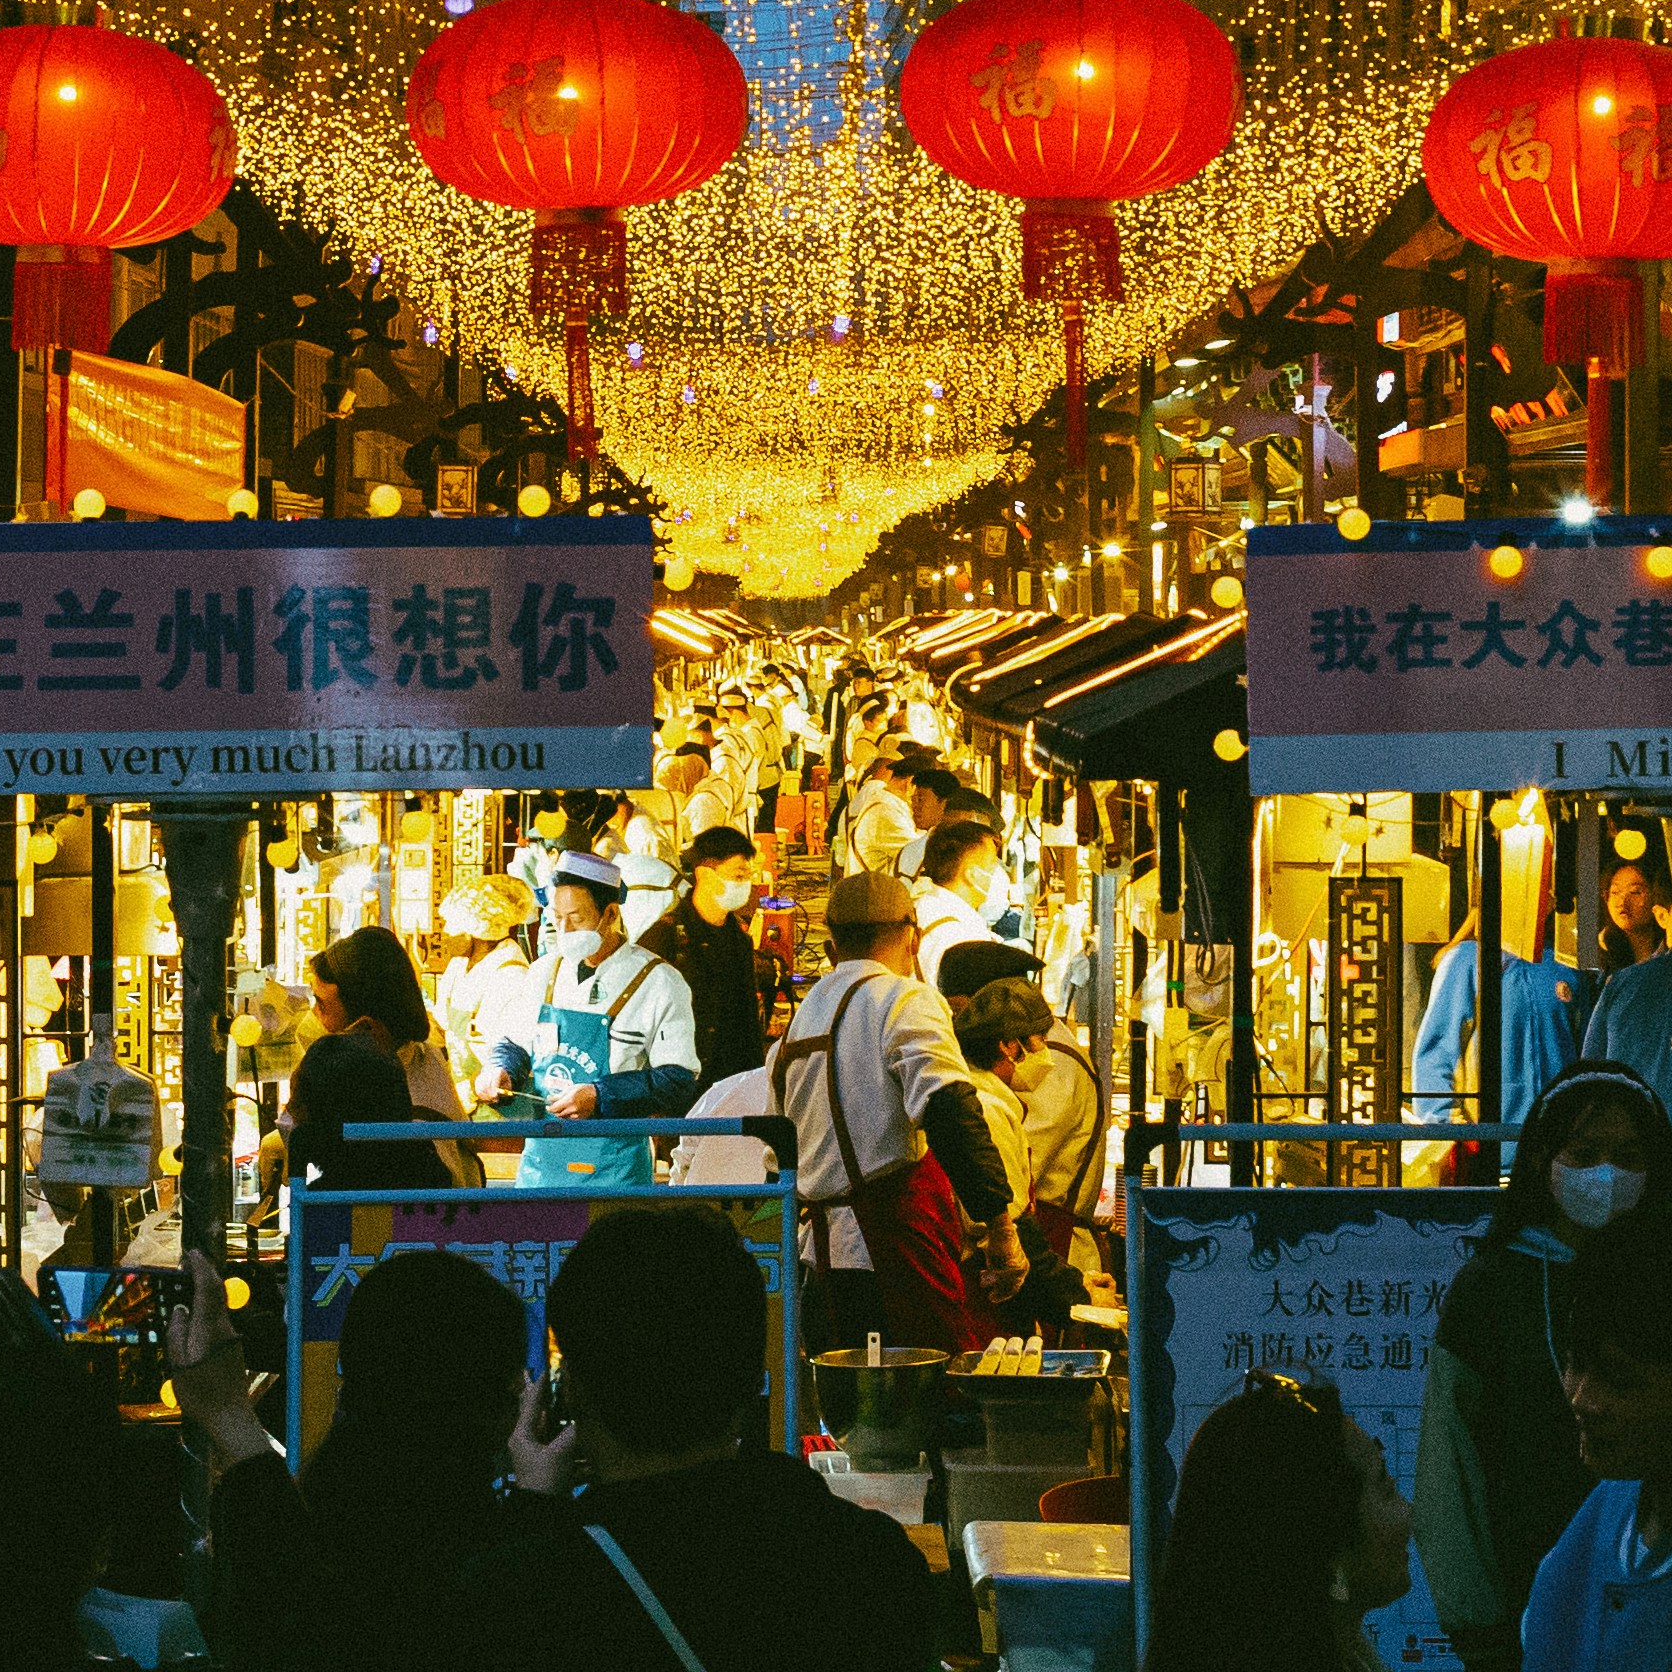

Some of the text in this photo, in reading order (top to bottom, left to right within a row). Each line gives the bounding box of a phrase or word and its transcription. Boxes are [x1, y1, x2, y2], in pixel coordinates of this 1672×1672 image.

[970, 38, 1058, 123] 福
[1469, 101, 1554, 187] 福
[4, 747, 85, 788] you
[98, 745, 197, 788] very
[210, 730, 337, 775] much
[354, 730, 547, 775] Lanzhou
[1551, 741, 1566, 778] I
